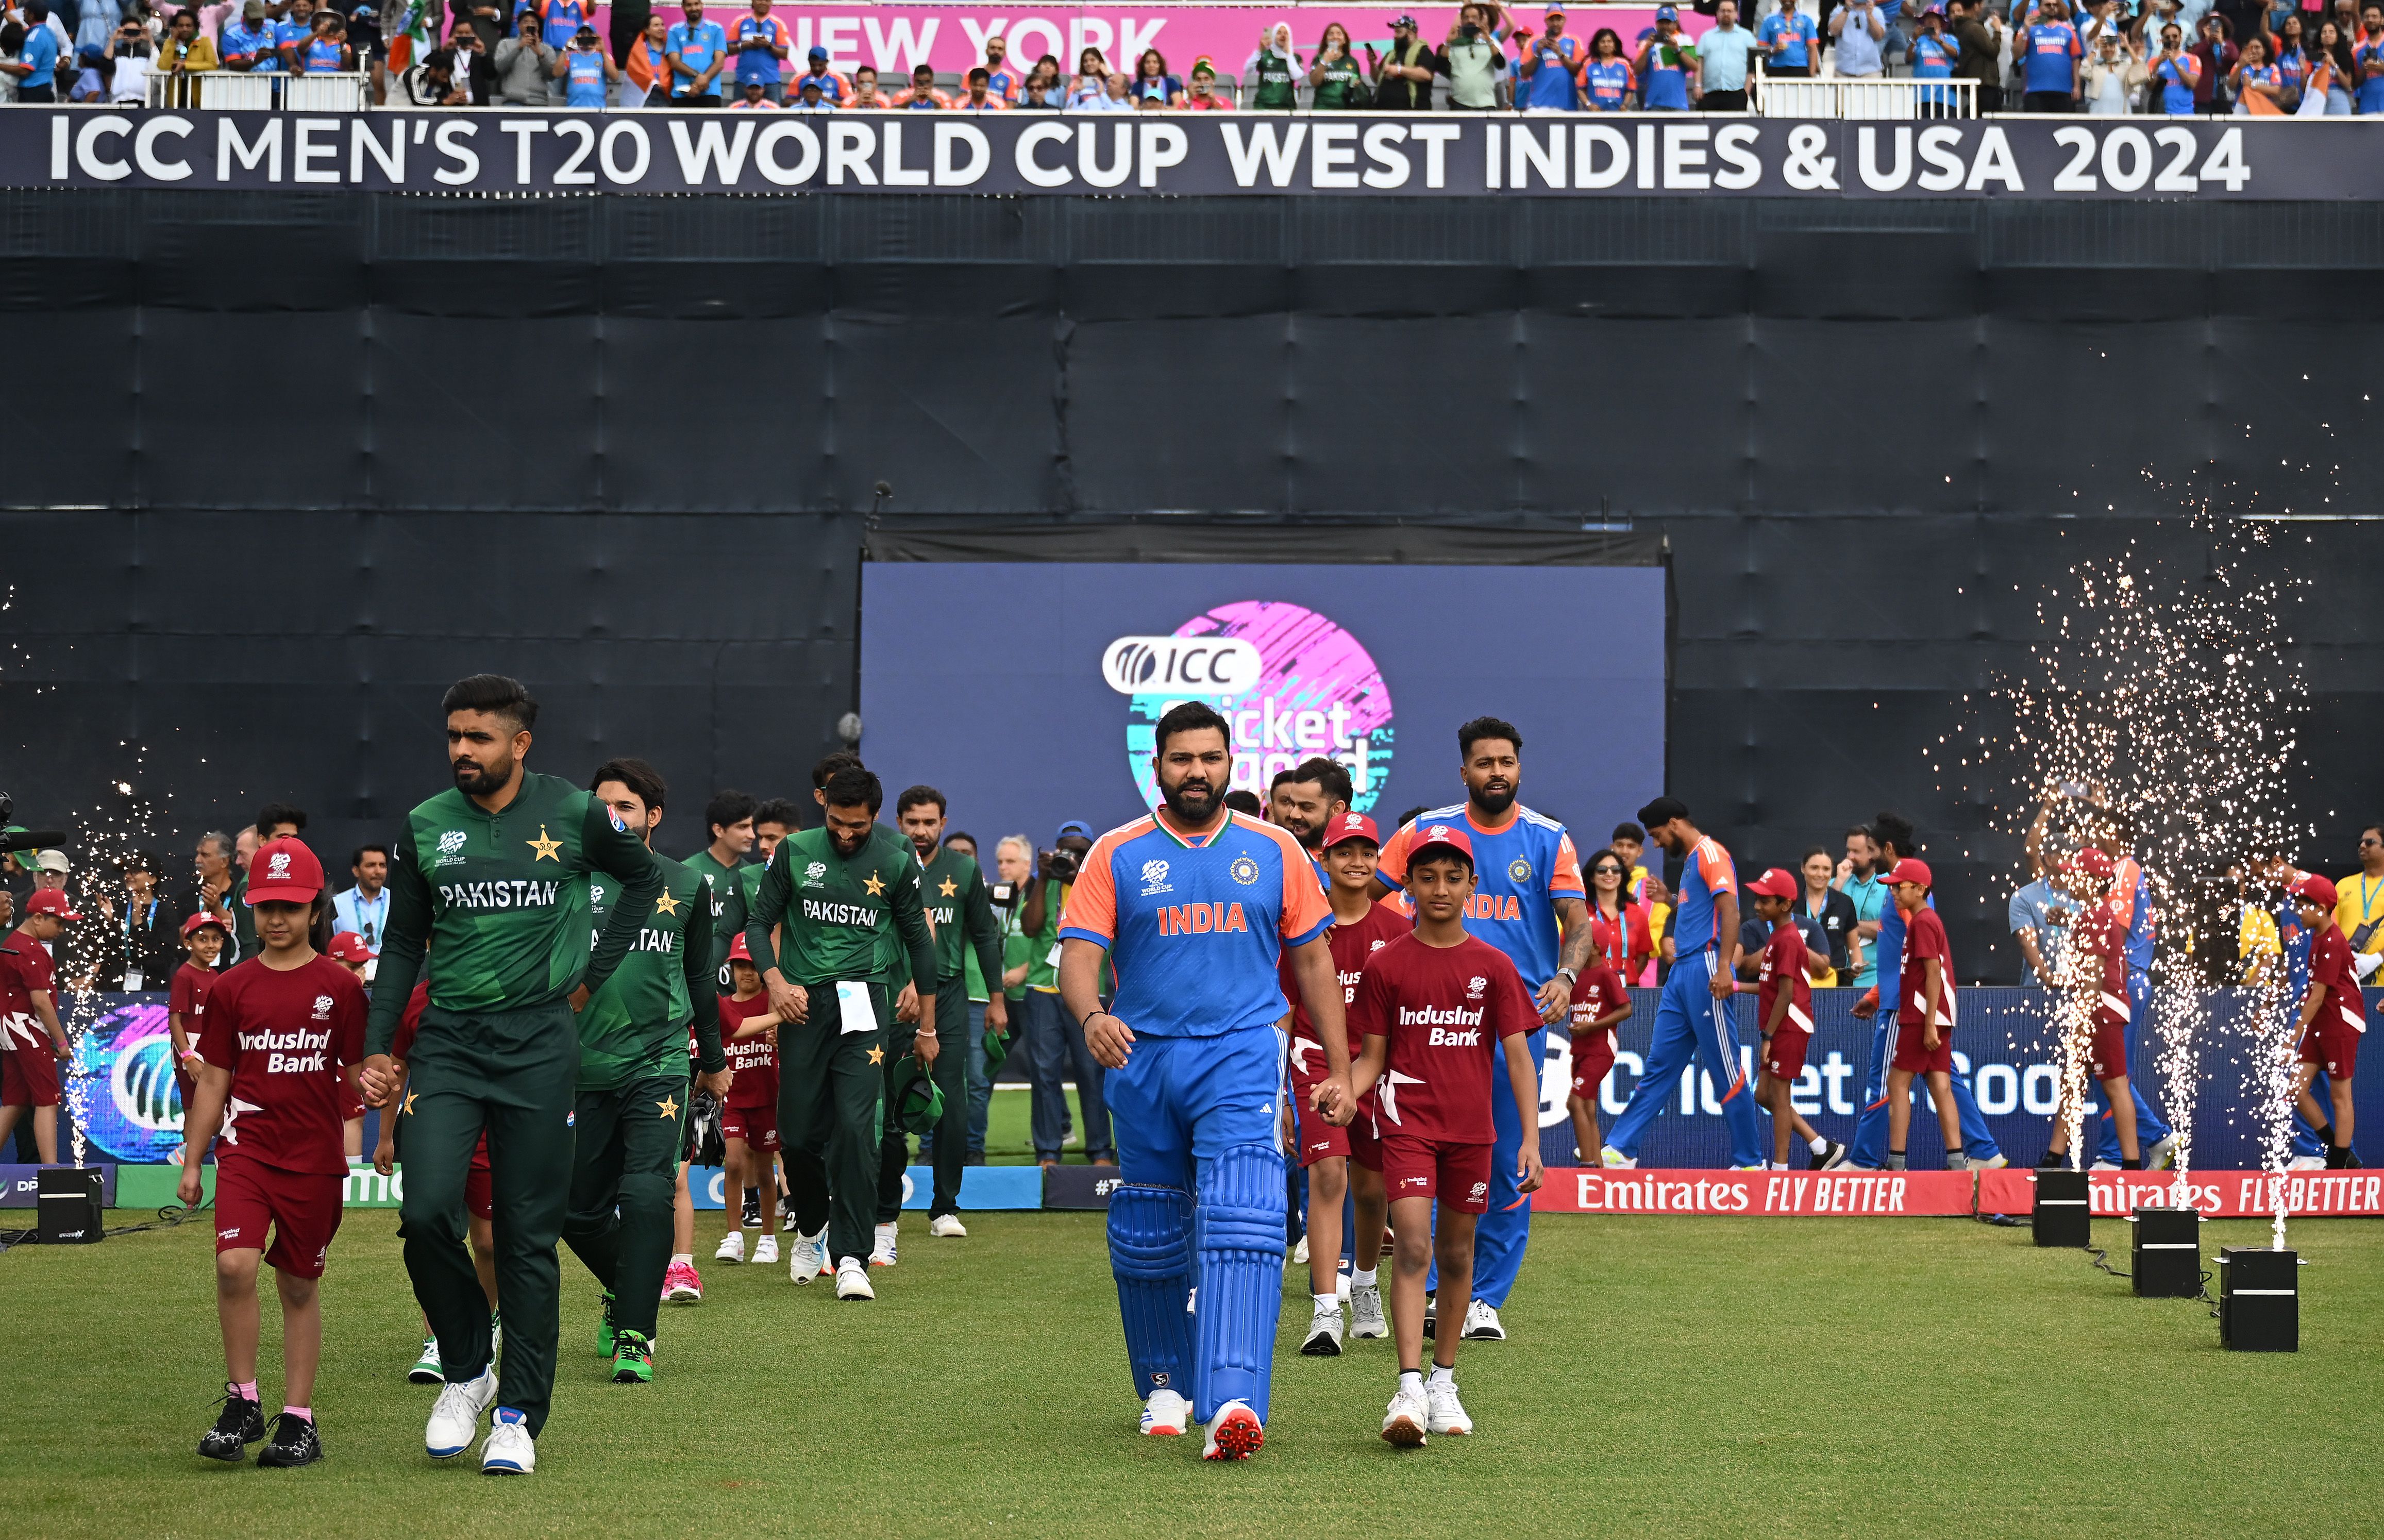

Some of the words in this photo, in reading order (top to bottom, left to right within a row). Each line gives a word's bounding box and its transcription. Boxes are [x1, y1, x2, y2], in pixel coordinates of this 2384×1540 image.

[785, 17, 942, 76] NEW
[959, 17, 1168, 75] YORK
[52, 114, 193, 181] ICC
[217, 118, 480, 185] MEN'S
[501, 119, 651, 185] T20
[668, 120, 991, 186] WORLD
[1015, 121, 1188, 187] CUP
[1219, 122, 1460, 189] WEST
[1486, 124, 1762, 190] INDIES
[1783, 124, 1840, 190] &
[1858, 126, 2025, 192] USA
[2053, 126, 2251, 192] 2024
[1165, 648, 1236, 683] ICC
[439, 880, 559, 909] PAKISTAN
[1460, 894, 1522, 920] NDIA
[803, 899, 879, 927] PAKISTAN
[1157, 902, 1248, 936] INDIA
[1399, 1005, 1484, 1027] IndusInd
[238, 1028, 332, 1051] IndusInd
[723, 1040, 773, 1057] ndusInd
[1429, 1027, 1482, 1047] Bank
[266, 1052, 328, 1074] Bank
[735, 1053, 773, 1070] Bank
[1576, 1173, 1749, 1211] Emirates
[1765, 1177, 1808, 1212] FLY
[1814, 1177, 1906, 1212] BETTER
[2288, 1176, 2381, 1212] BETTER
[218, 1227, 241, 1237] IndusInd
